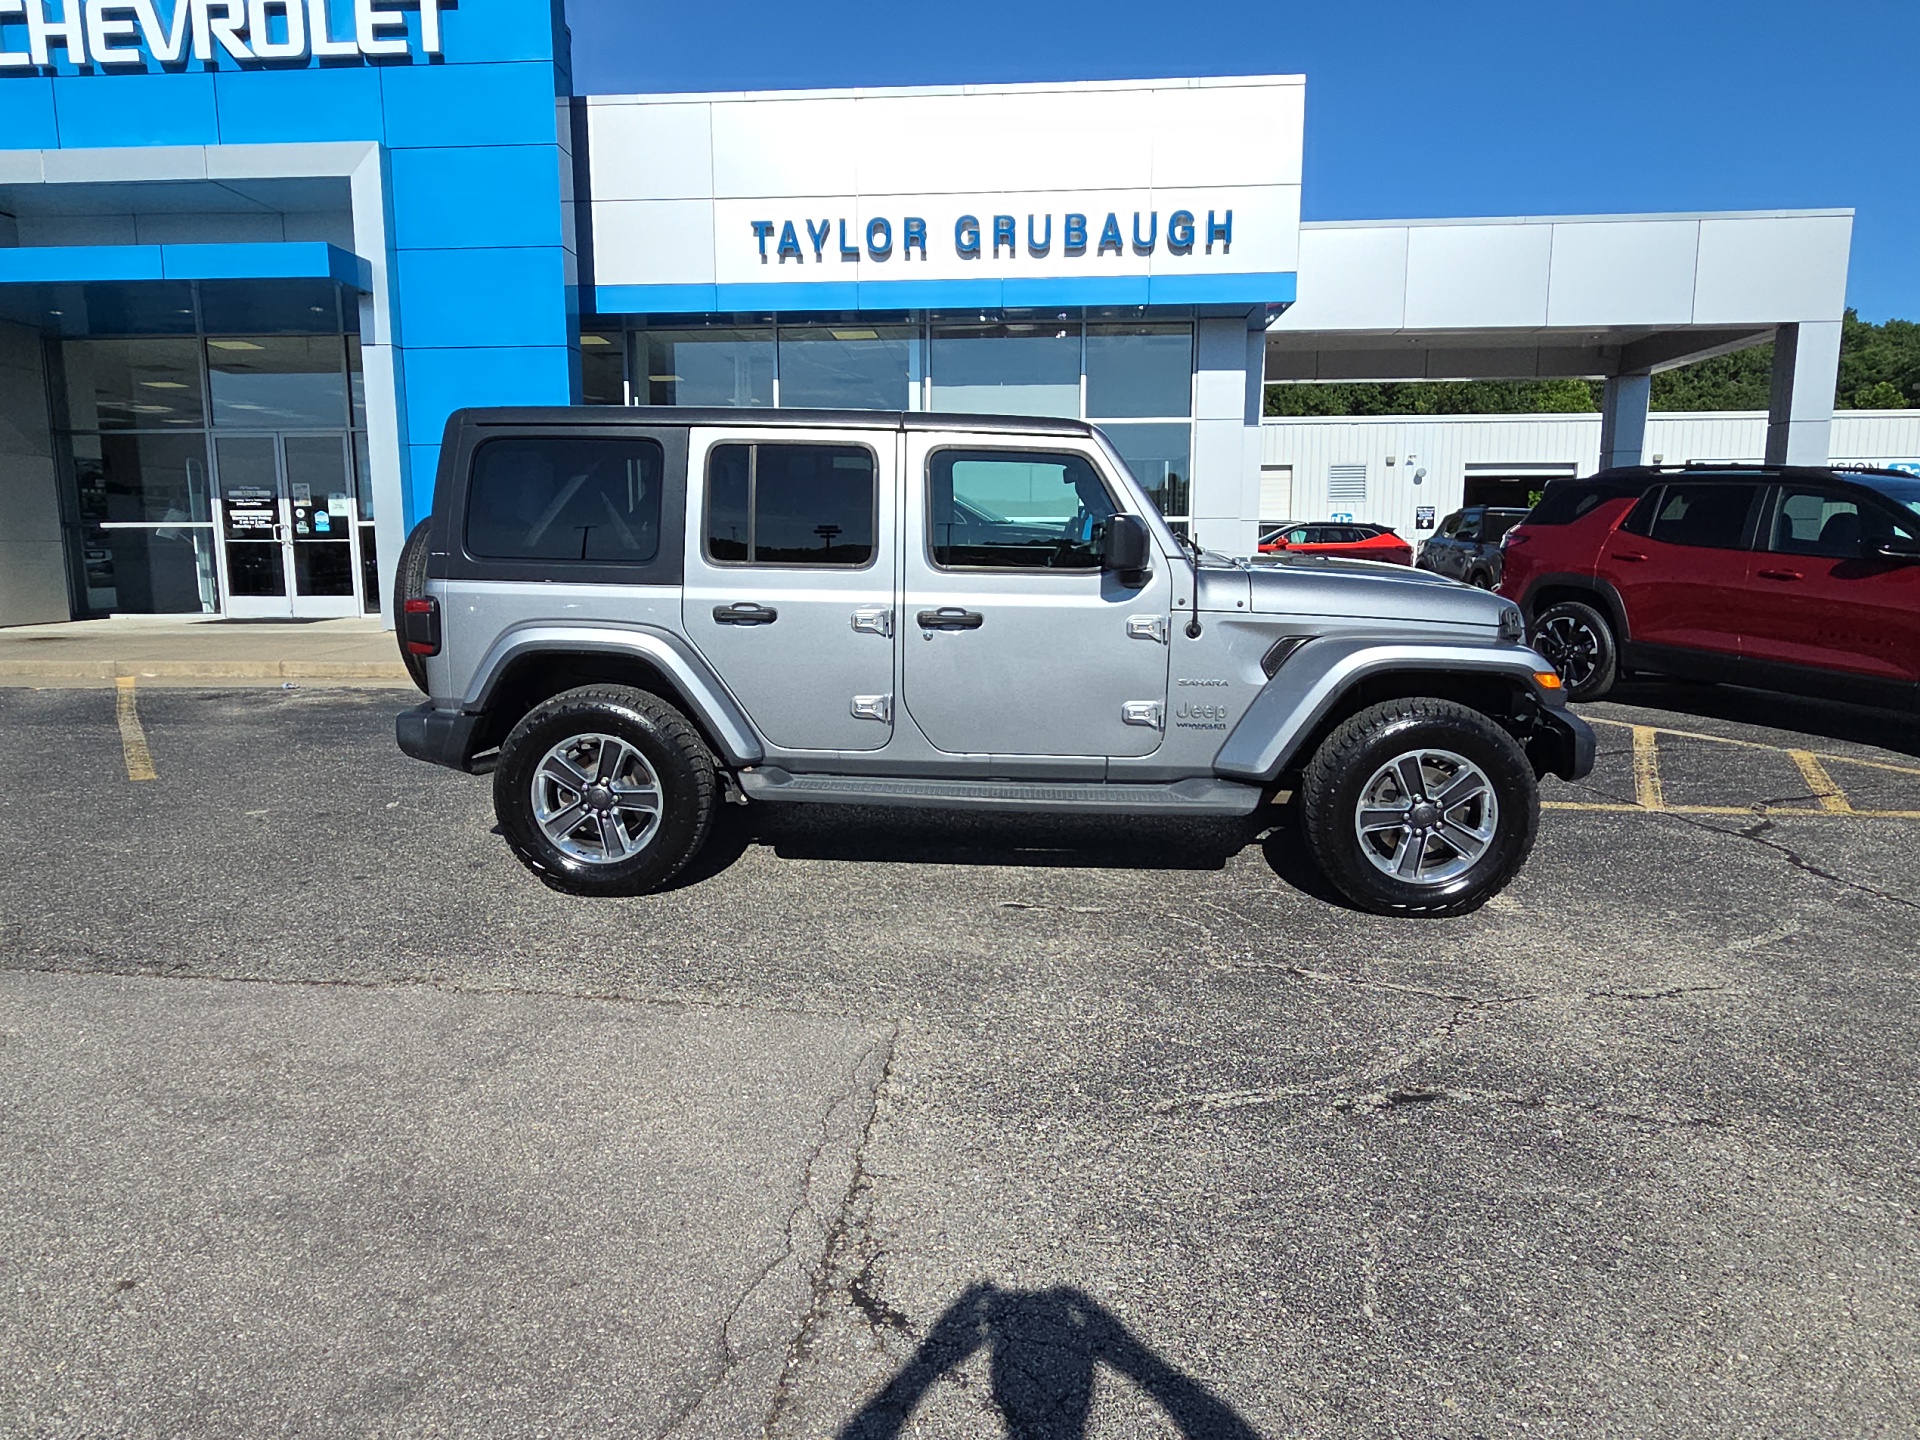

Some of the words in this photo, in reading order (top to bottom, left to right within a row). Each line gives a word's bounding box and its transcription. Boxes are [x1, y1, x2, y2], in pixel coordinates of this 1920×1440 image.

[751, 216, 928, 257] TAYLOR
[954, 209, 1233, 253] GRUBAUGH
[1177, 678, 1229, 687] SAHARA
[1176, 700, 1228, 722] Jeep
